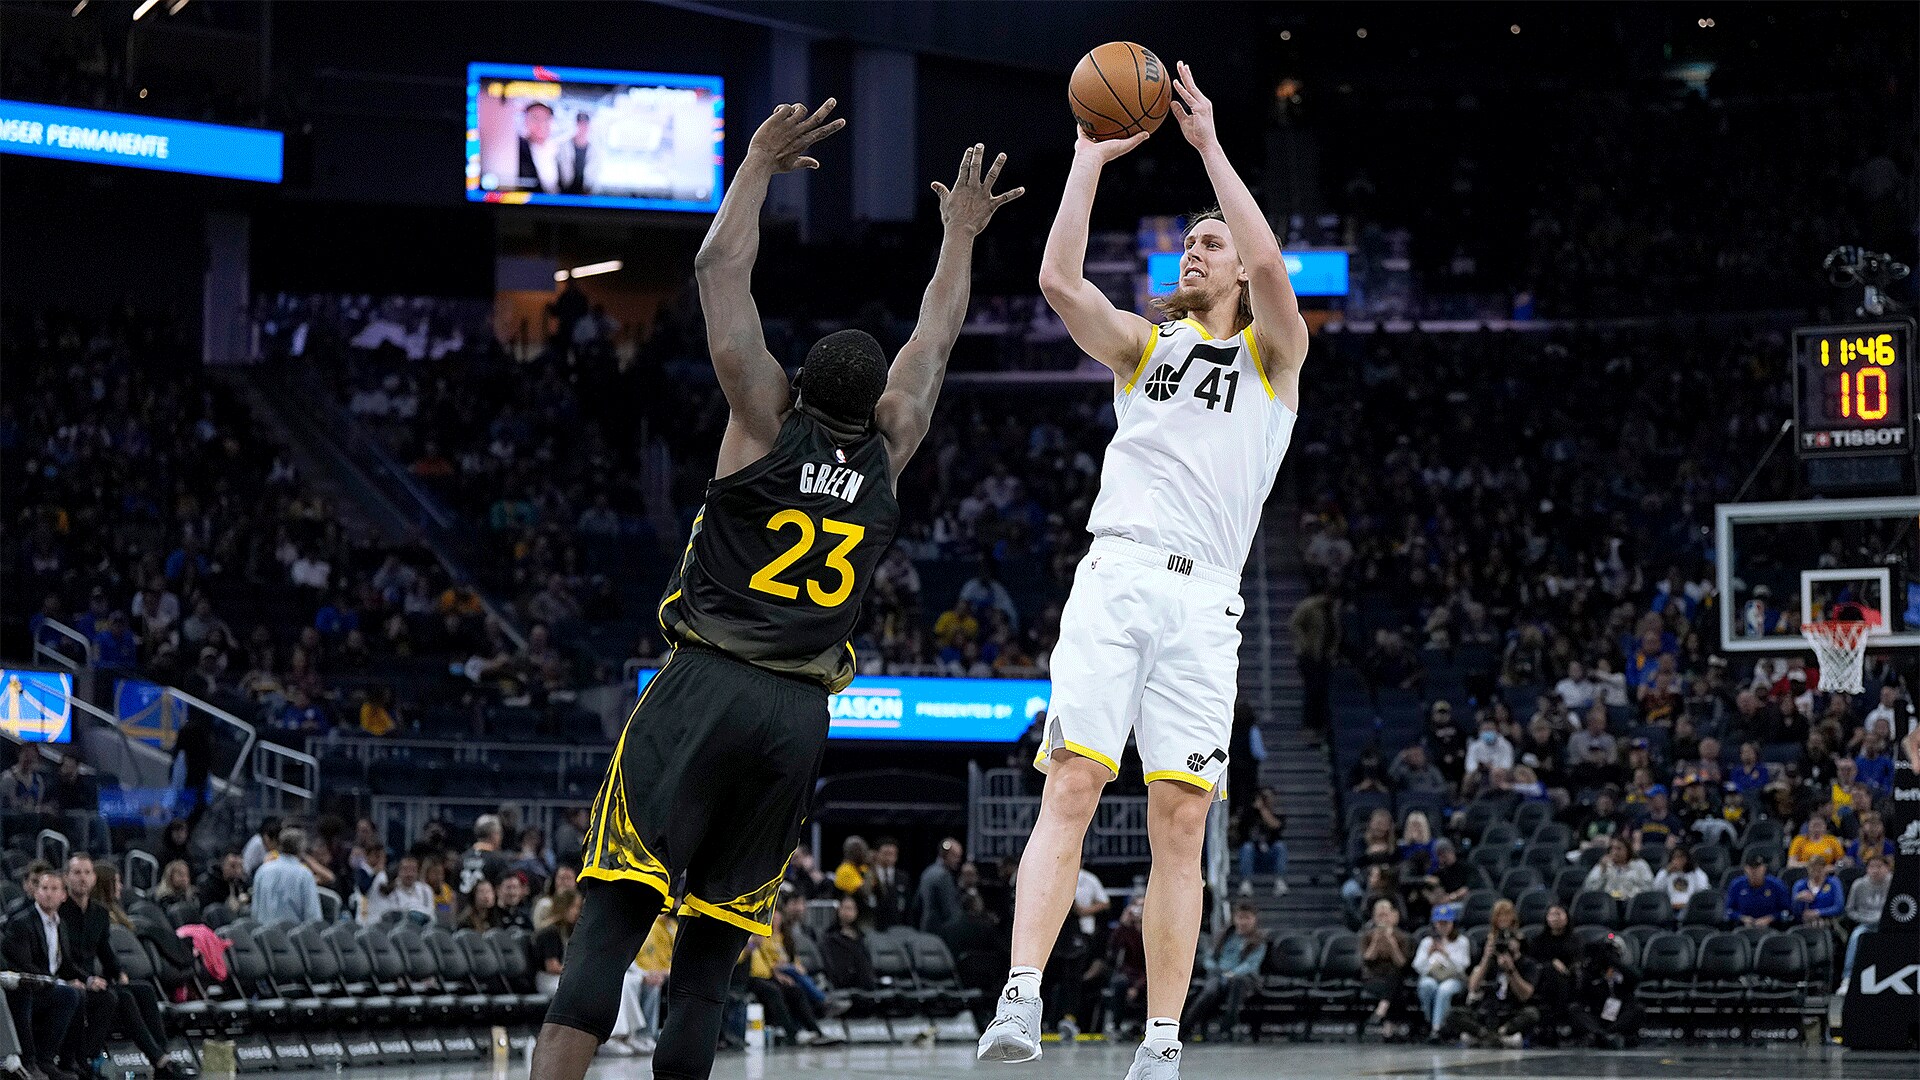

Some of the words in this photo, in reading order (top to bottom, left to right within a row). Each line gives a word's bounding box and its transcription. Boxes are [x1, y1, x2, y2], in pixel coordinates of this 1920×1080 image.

[46, 123, 169, 159] PERMANENTE
[1820, 333, 1896, 367] 11:46
[1193, 366, 1240, 414] 41
[1840, 366, 1888, 421] 10
[1830, 427, 1906, 448] TISSOT
[800, 462, 865, 504] GREEN
[749, 508, 865, 608] 23
[1166, 553, 1194, 577] UTAH
